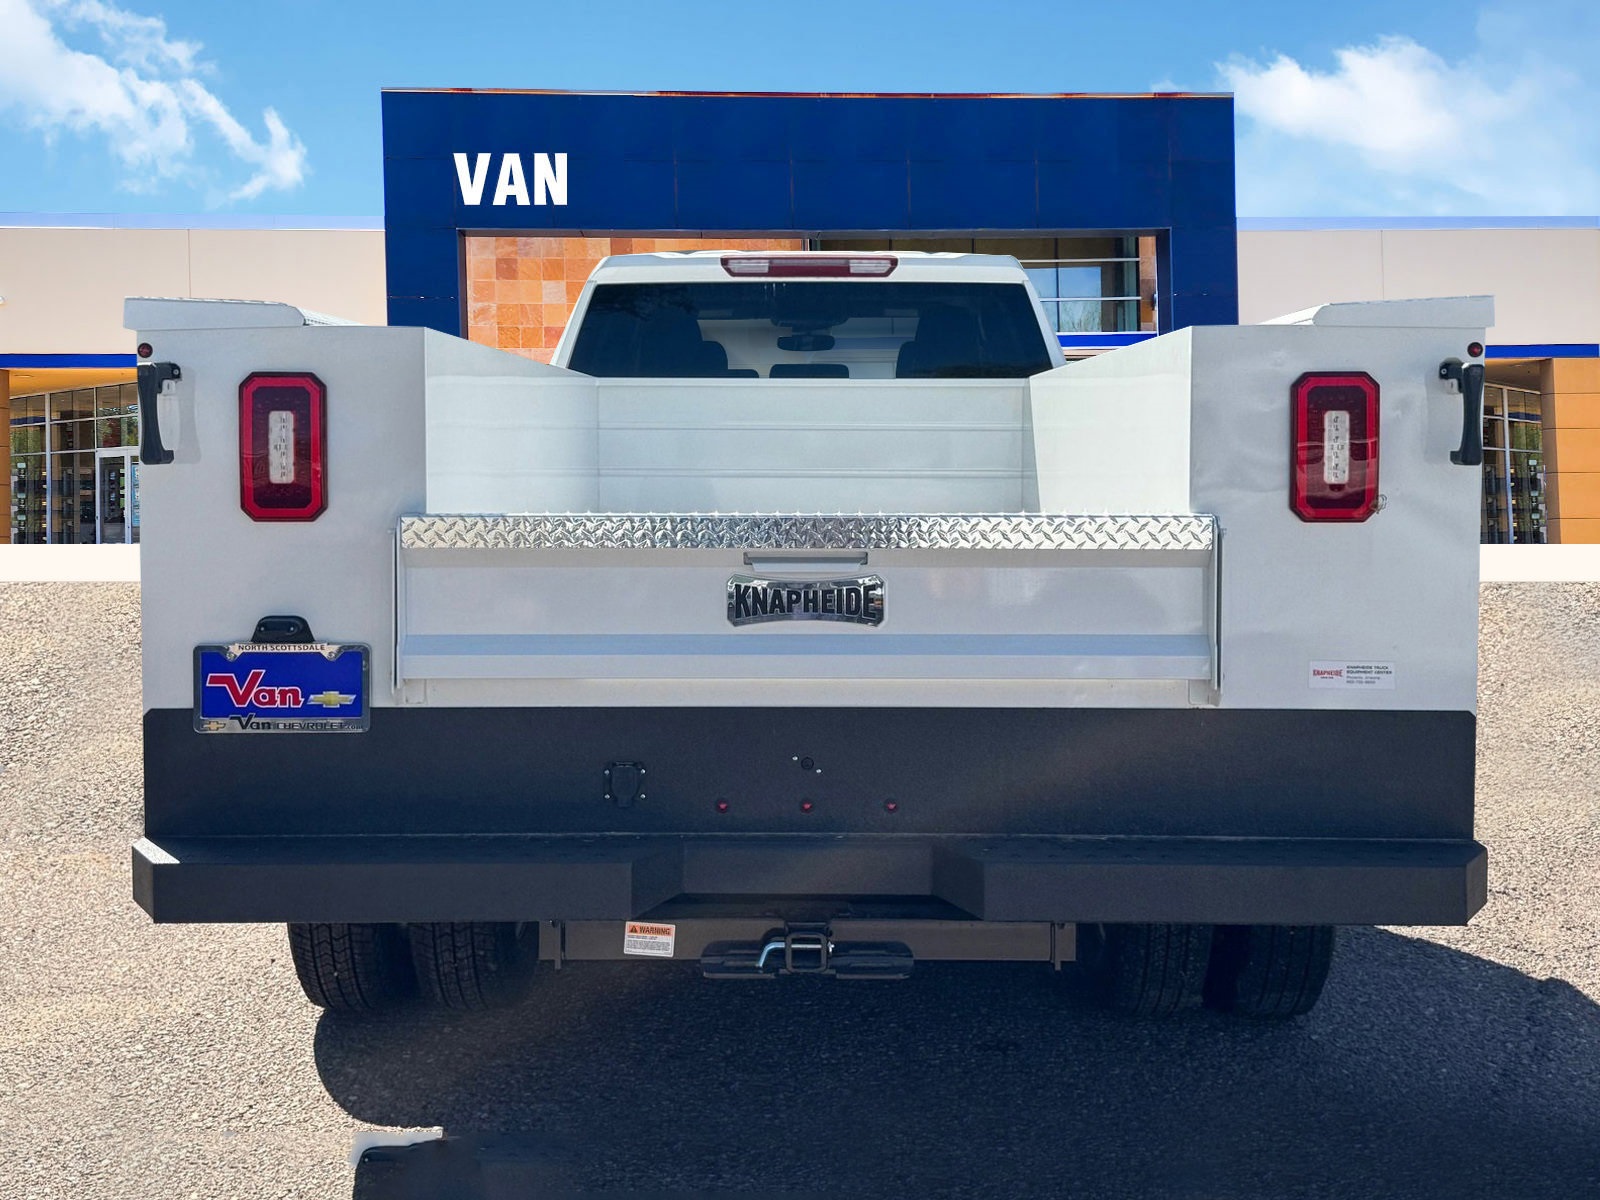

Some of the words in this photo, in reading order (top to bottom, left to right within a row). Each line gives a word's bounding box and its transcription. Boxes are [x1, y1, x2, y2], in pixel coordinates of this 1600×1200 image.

[453, 153, 568, 206] VAN
[734, 583, 877, 620] KNAPHEIDE
[206, 669, 305, 708] Van
[229, 713, 271, 731] Van
[639, 926, 670, 935] WARNING
